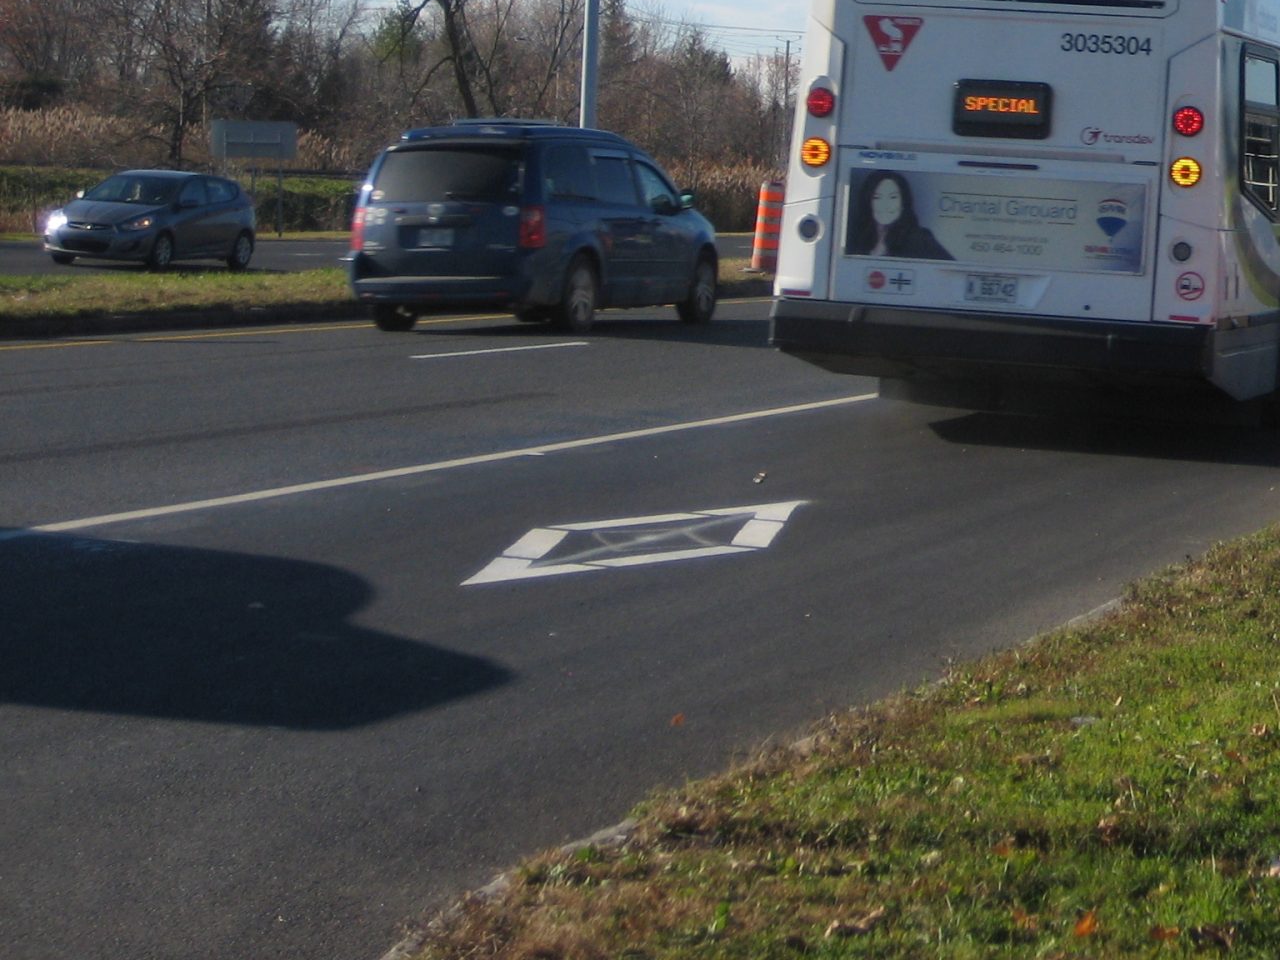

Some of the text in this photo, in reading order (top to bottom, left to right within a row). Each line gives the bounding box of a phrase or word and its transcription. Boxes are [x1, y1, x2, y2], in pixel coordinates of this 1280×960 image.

[1061, 33, 1152, 56] 3035304
[964, 96, 1039, 114] SPECIAL
[939, 196, 1077, 220] Chantal Girouard
